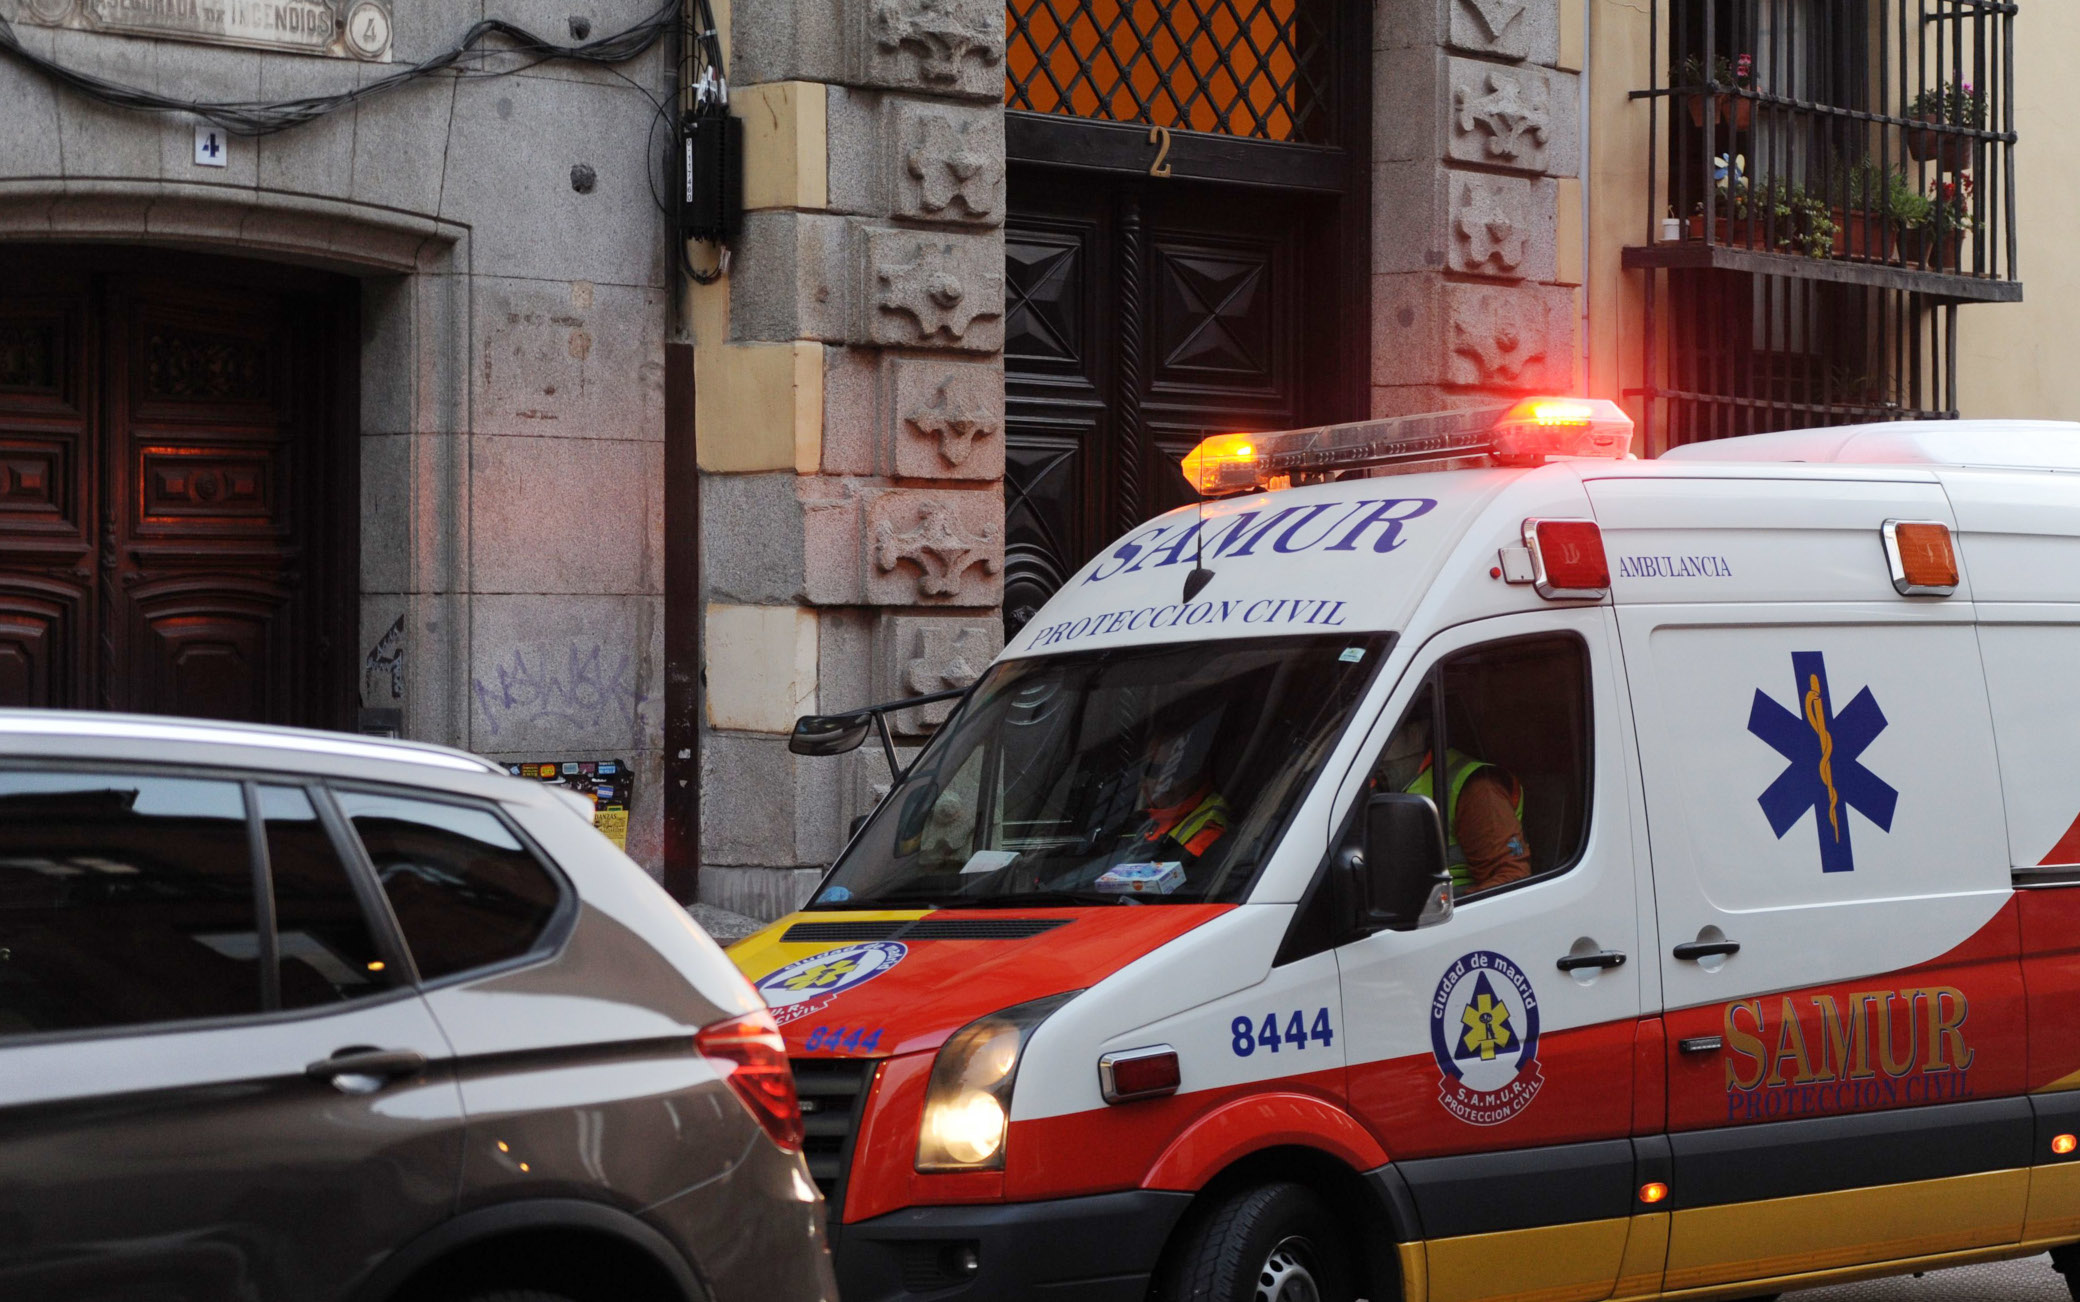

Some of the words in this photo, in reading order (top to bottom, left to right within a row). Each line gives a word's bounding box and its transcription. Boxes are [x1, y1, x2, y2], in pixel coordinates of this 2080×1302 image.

[231, 4, 329, 33] INCENDIOS
[363, 17, 377, 41] 4
[202, 133, 220, 158] 4
[1151, 126, 1171, 178] 2
[1082, 498, 1438, 586] SAMUR
[1620, 556, 1732, 578] AMBULANCIA
[1025, 600, 1241, 651] PROTECCION
[1243, 600, 1347, 626] CIVIL
[594, 813, 617, 821] DANZAS
[784, 945, 857, 971] ciudad
[1433, 960, 1465, 1019] ciudad
[1470, 952, 1488, 967] de
[1494, 957, 1536, 1010] madrid
[776, 1005, 819, 1024] CIVIL
[805, 1026, 885, 1053] 8444
[1231, 1007, 1333, 1057] 8444
[1724, 986, 1975, 1092] SAMUR
[1444, 1094, 1511, 1122] PROTECCION
[1513, 1080, 1540, 1110] CIVIL
[1457, 1081, 1526, 1107] S.A.M.U.R.
[1727, 1077, 1899, 1121] PROTECCION
[1905, 1071, 1973, 1100] CIVIL
